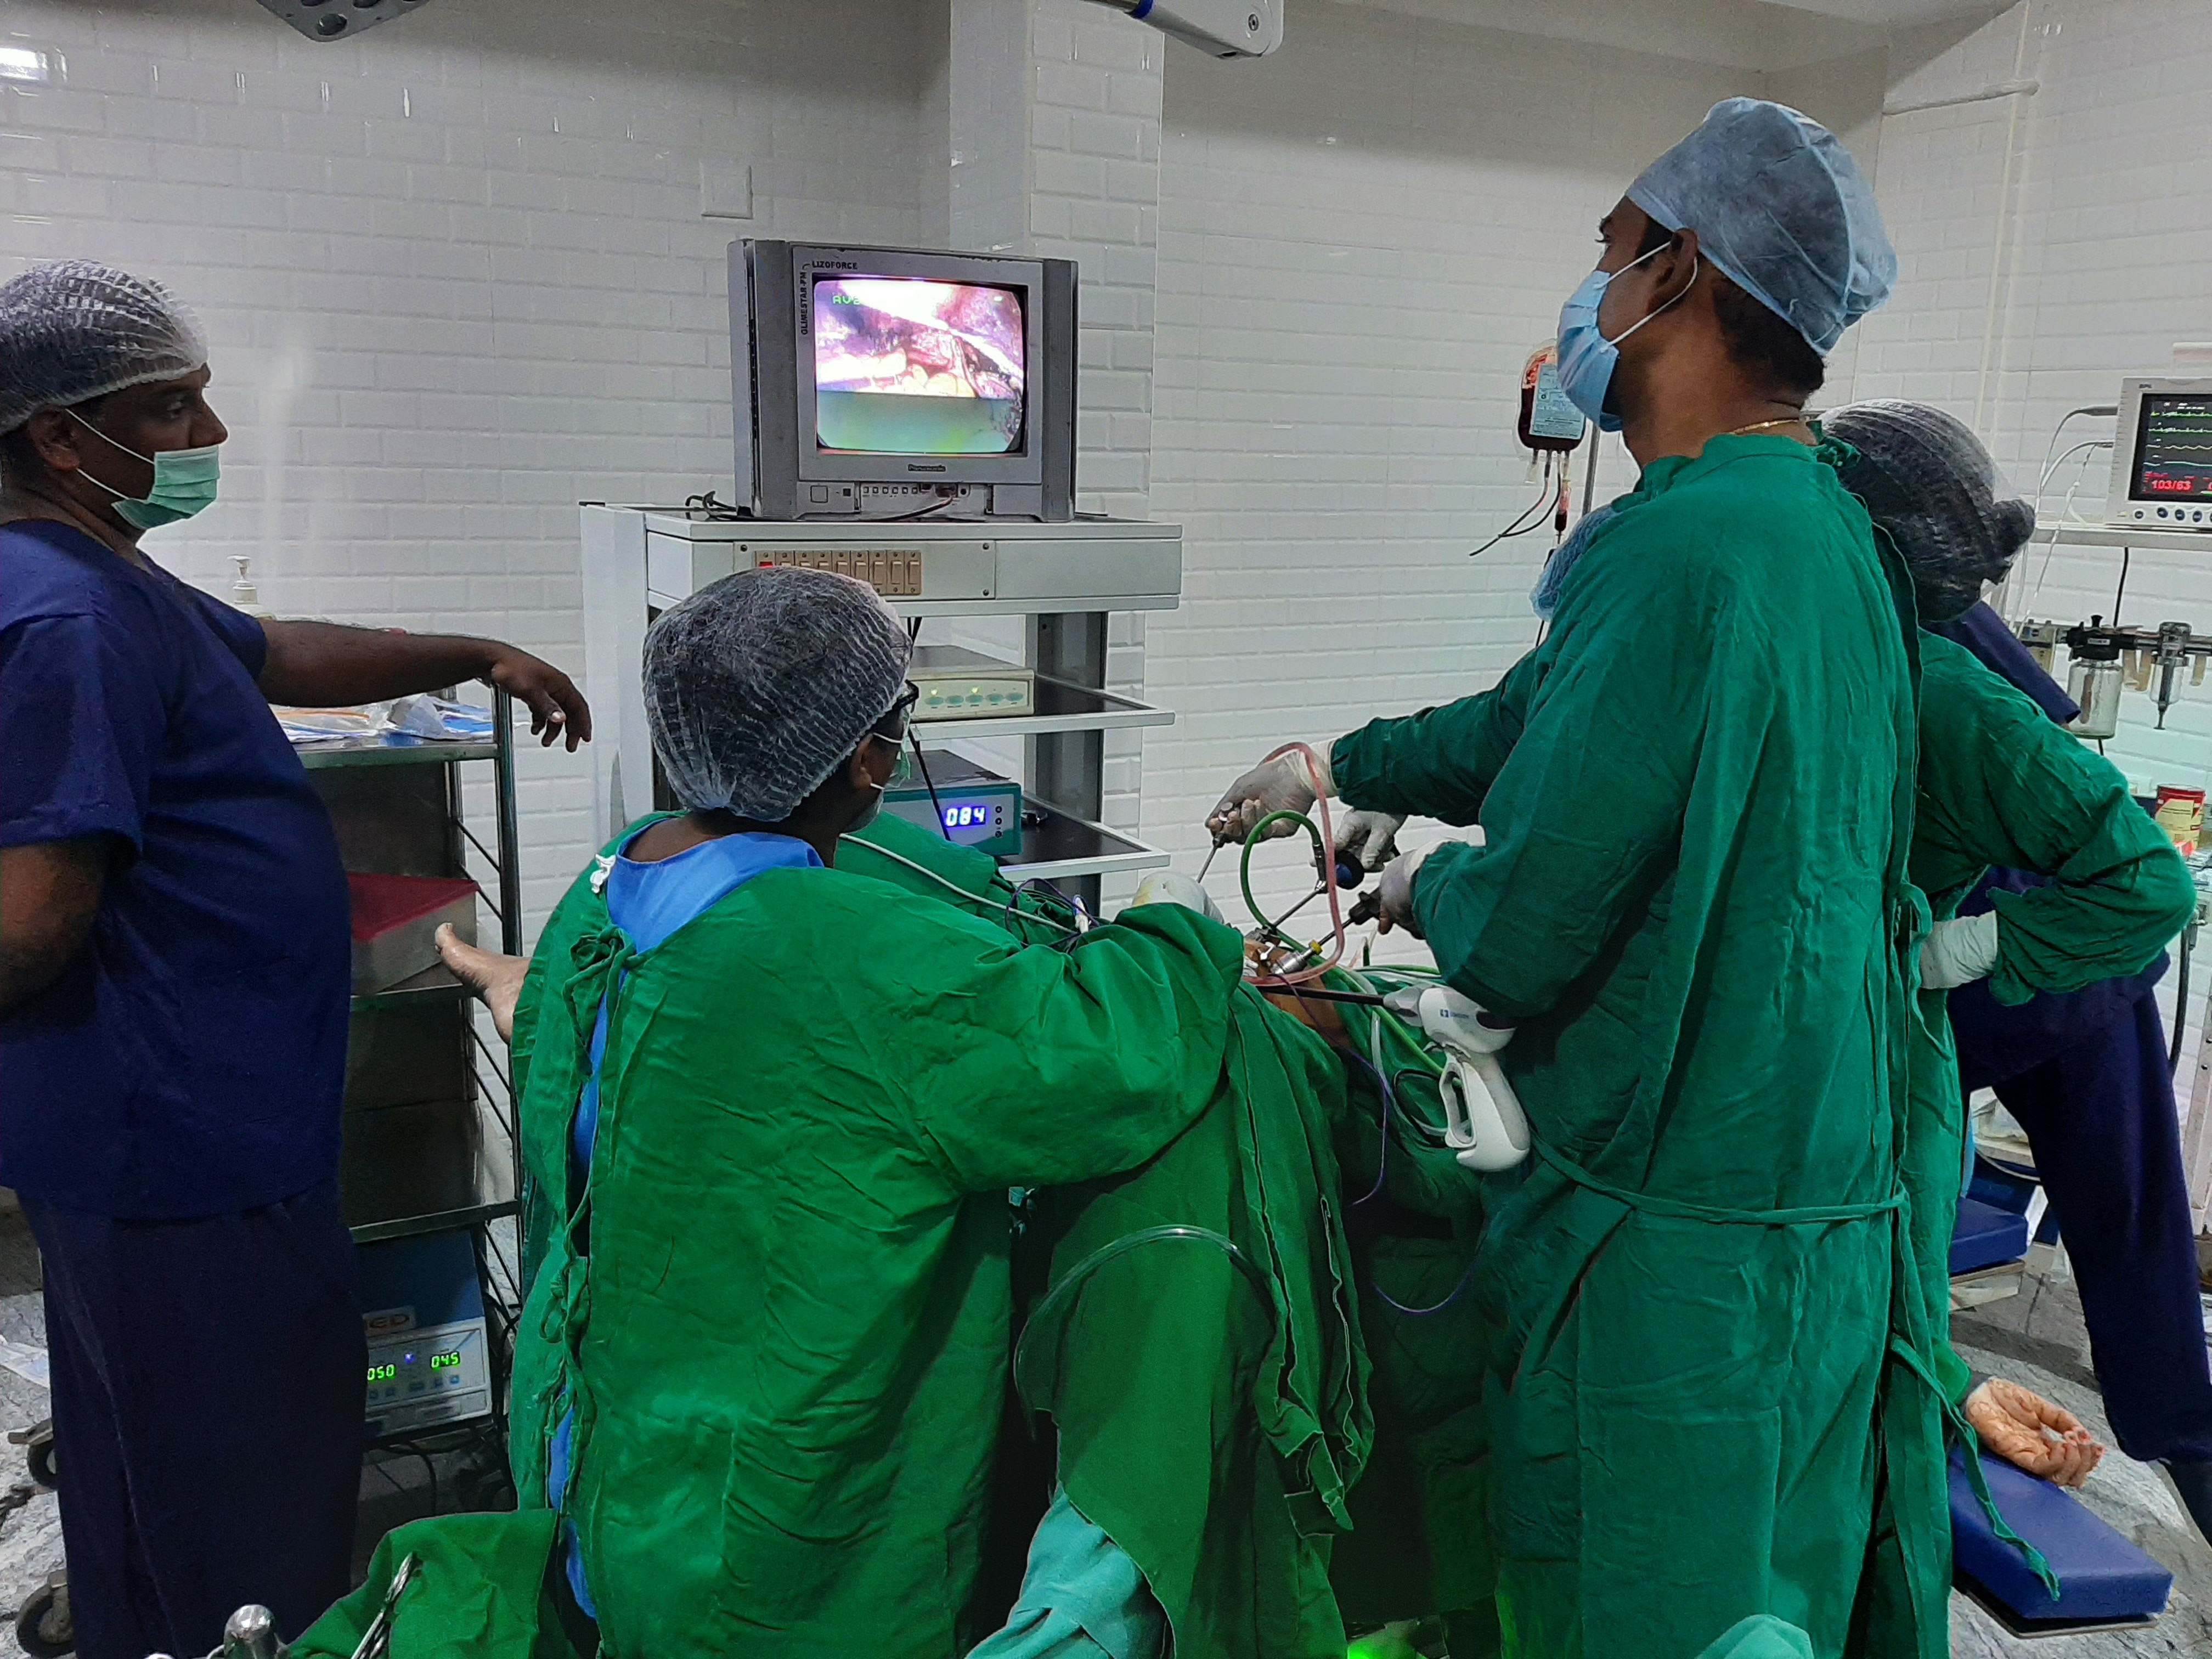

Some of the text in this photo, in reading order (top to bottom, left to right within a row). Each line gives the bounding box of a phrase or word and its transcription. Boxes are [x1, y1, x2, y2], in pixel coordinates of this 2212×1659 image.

[812, 261, 857, 269] LIZOFORCE
[946, 806, 985, 827] 084
[431, 1352, 459, 1368] 045
[367, 1364, 395, 1381] 050
